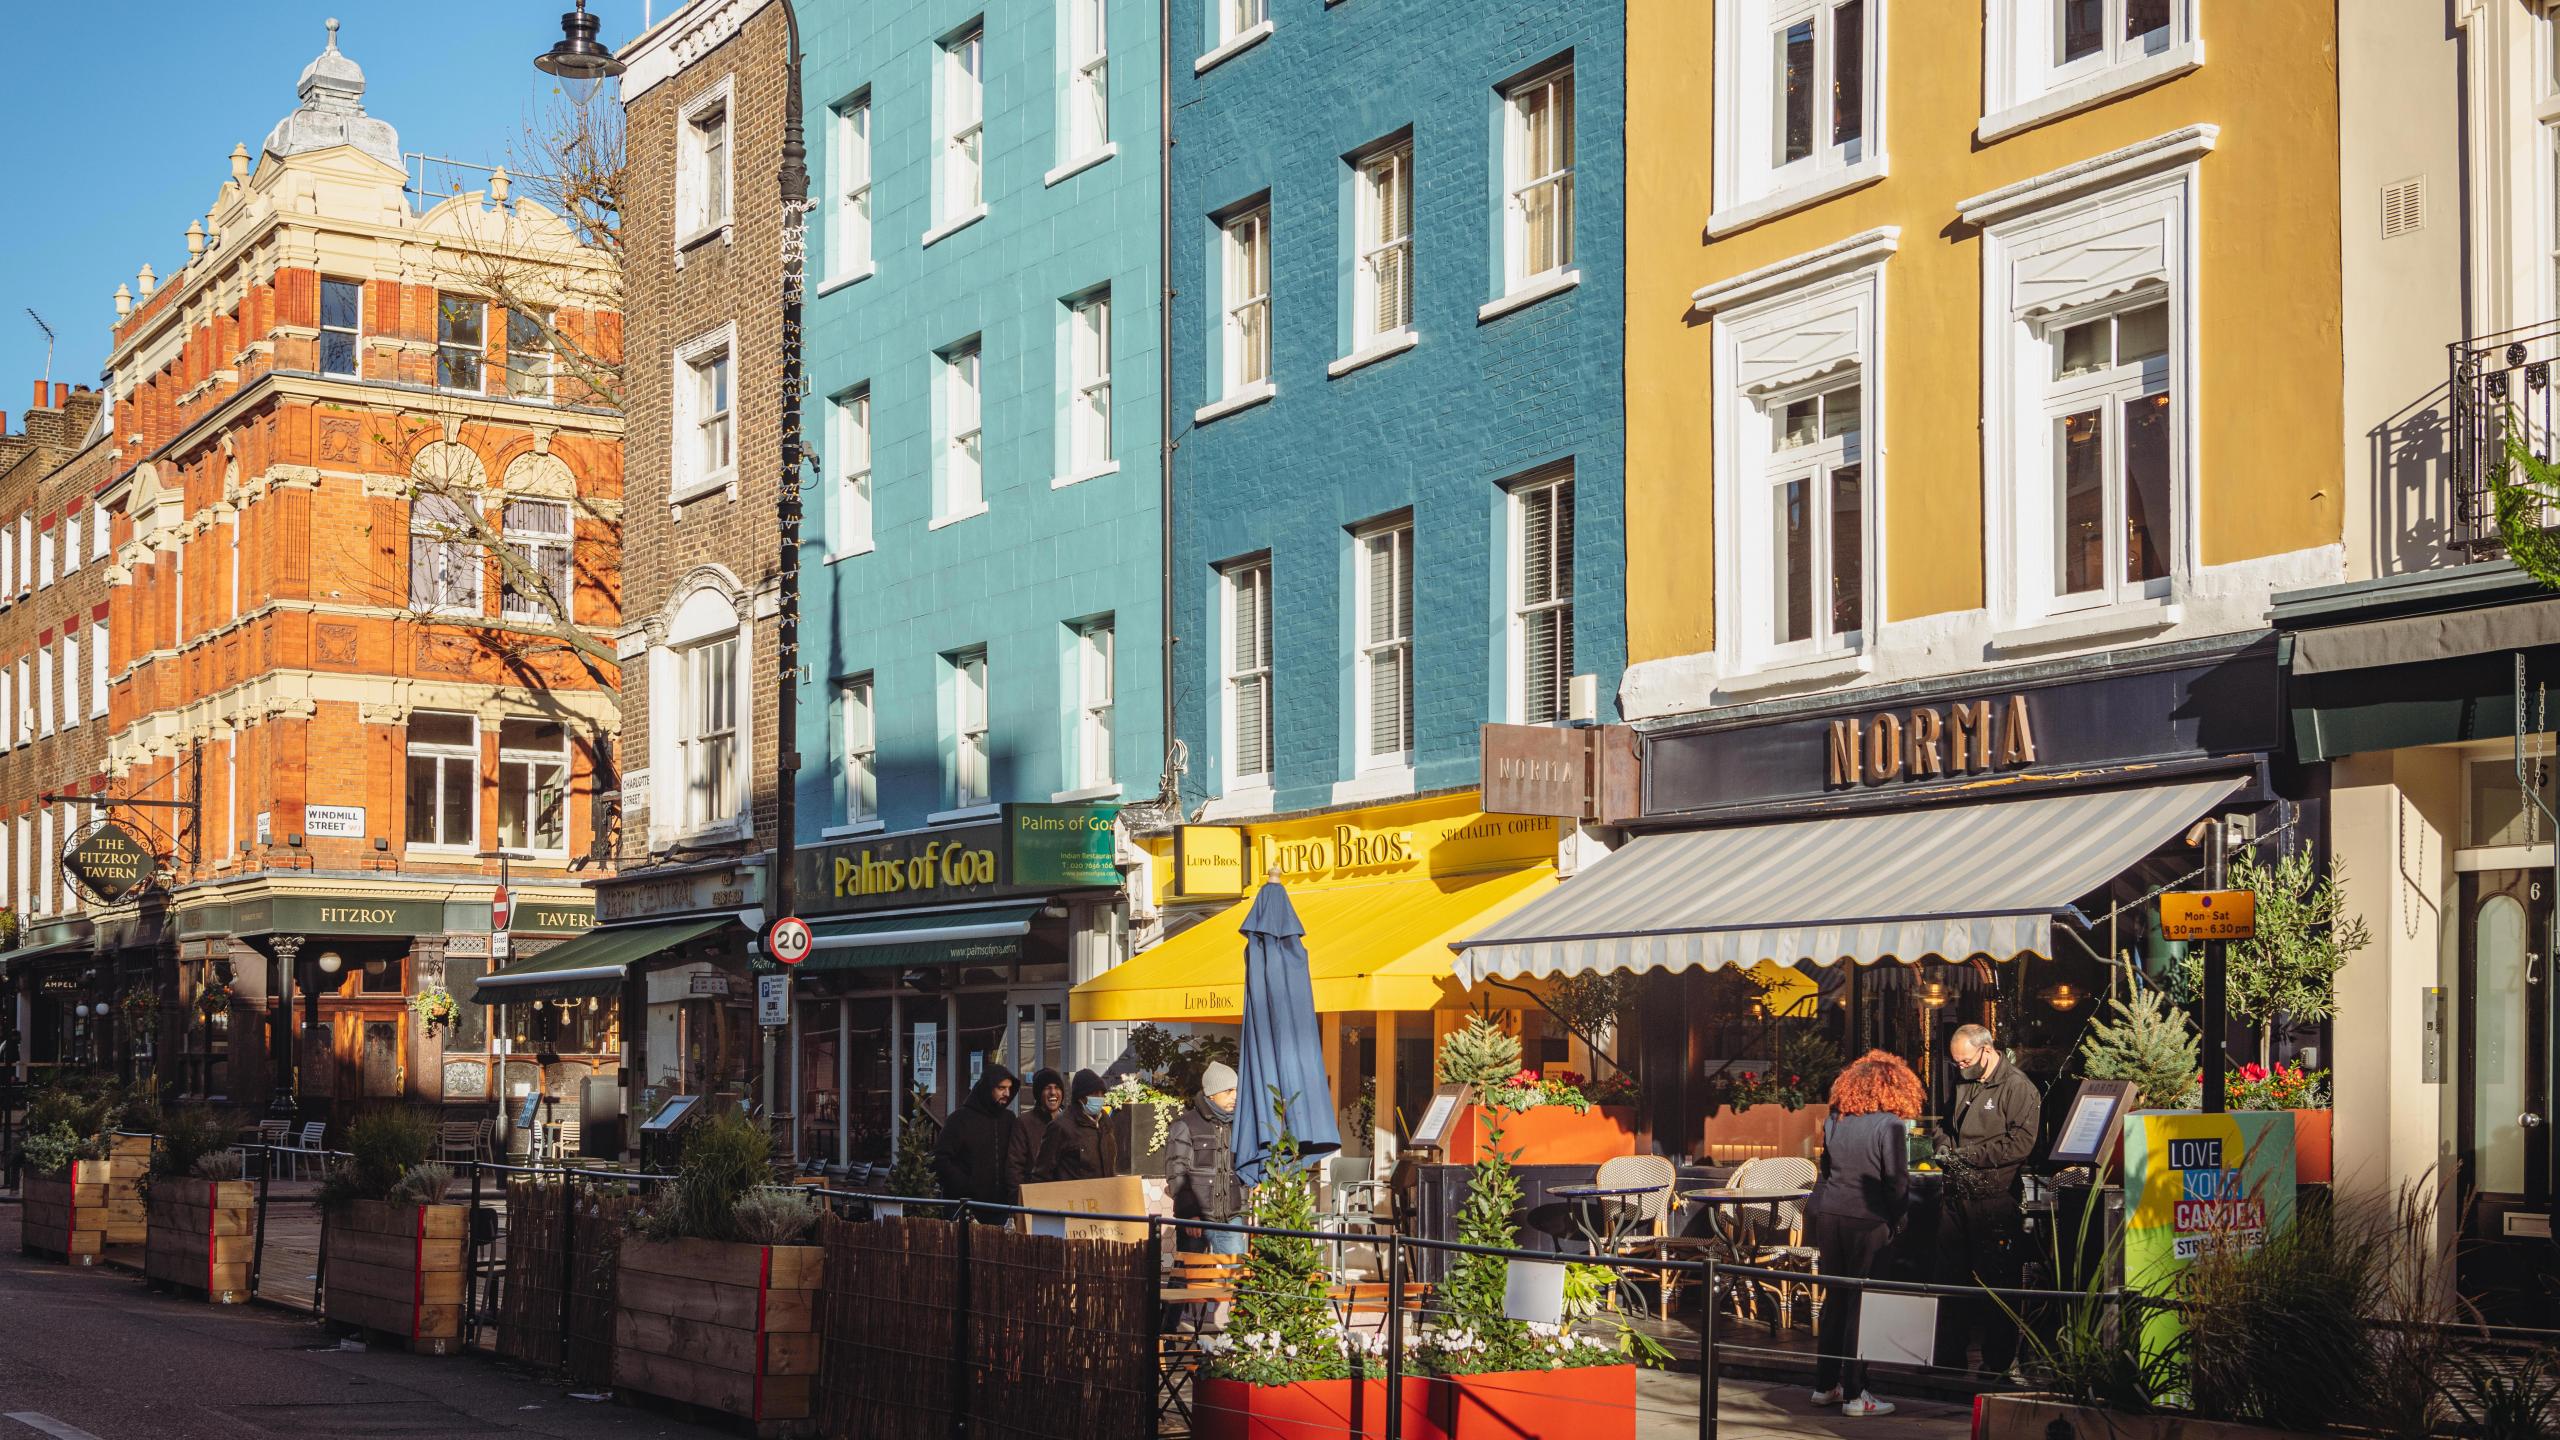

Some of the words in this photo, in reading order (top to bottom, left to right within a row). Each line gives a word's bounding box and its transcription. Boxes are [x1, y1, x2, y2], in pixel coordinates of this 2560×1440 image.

[1830, 695, 2036, 785] NORMA
[1500, 757, 1573, 783] NORMA
[623, 775, 650, 790] CHARLOTTE
[623, 793, 641, 807] STREET
[308, 810, 358, 821] WINDMILL
[1022, 815, 1065, 830] Palms
[1068, 815, 1085, 831] of
[1088, 816, 1115, 831] Goa
[308, 821, 346, 831] STREET
[1441, 821, 1503, 842] SPECIALITY
[1508, 816, 1552, 835] COFFEE
[96, 839, 125, 850] THE
[79, 852, 141, 865] FITZROY
[83, 866, 137, 879] TAVERN
[834, 849, 905, 897] Palms
[908, 841, 940, 890] of
[941, 841, 995, 887] Goa
[638, 880, 697, 913] CENTRAL
[2530, 882, 2541, 901] 6
[320, 907, 397, 924] FITZROY
[537, 912, 602, 927] TAVERN
[2184, 912, 2205, 921] Mon
[2212, 911, 2230, 920] Sat
[2188, 926, 2203, 934] am
[2209, 924, 2234, 935] 6.30
[2235, 925, 2250, 935] pm
[777, 931, 806, 951] 20
[921, 1043, 930, 1061] 25
[2171, 1141, 2220, 1168] LOVE
[2186, 1172, 2240, 1199] YOUR
[2177, 1202, 2261, 1229] CAMDEN
